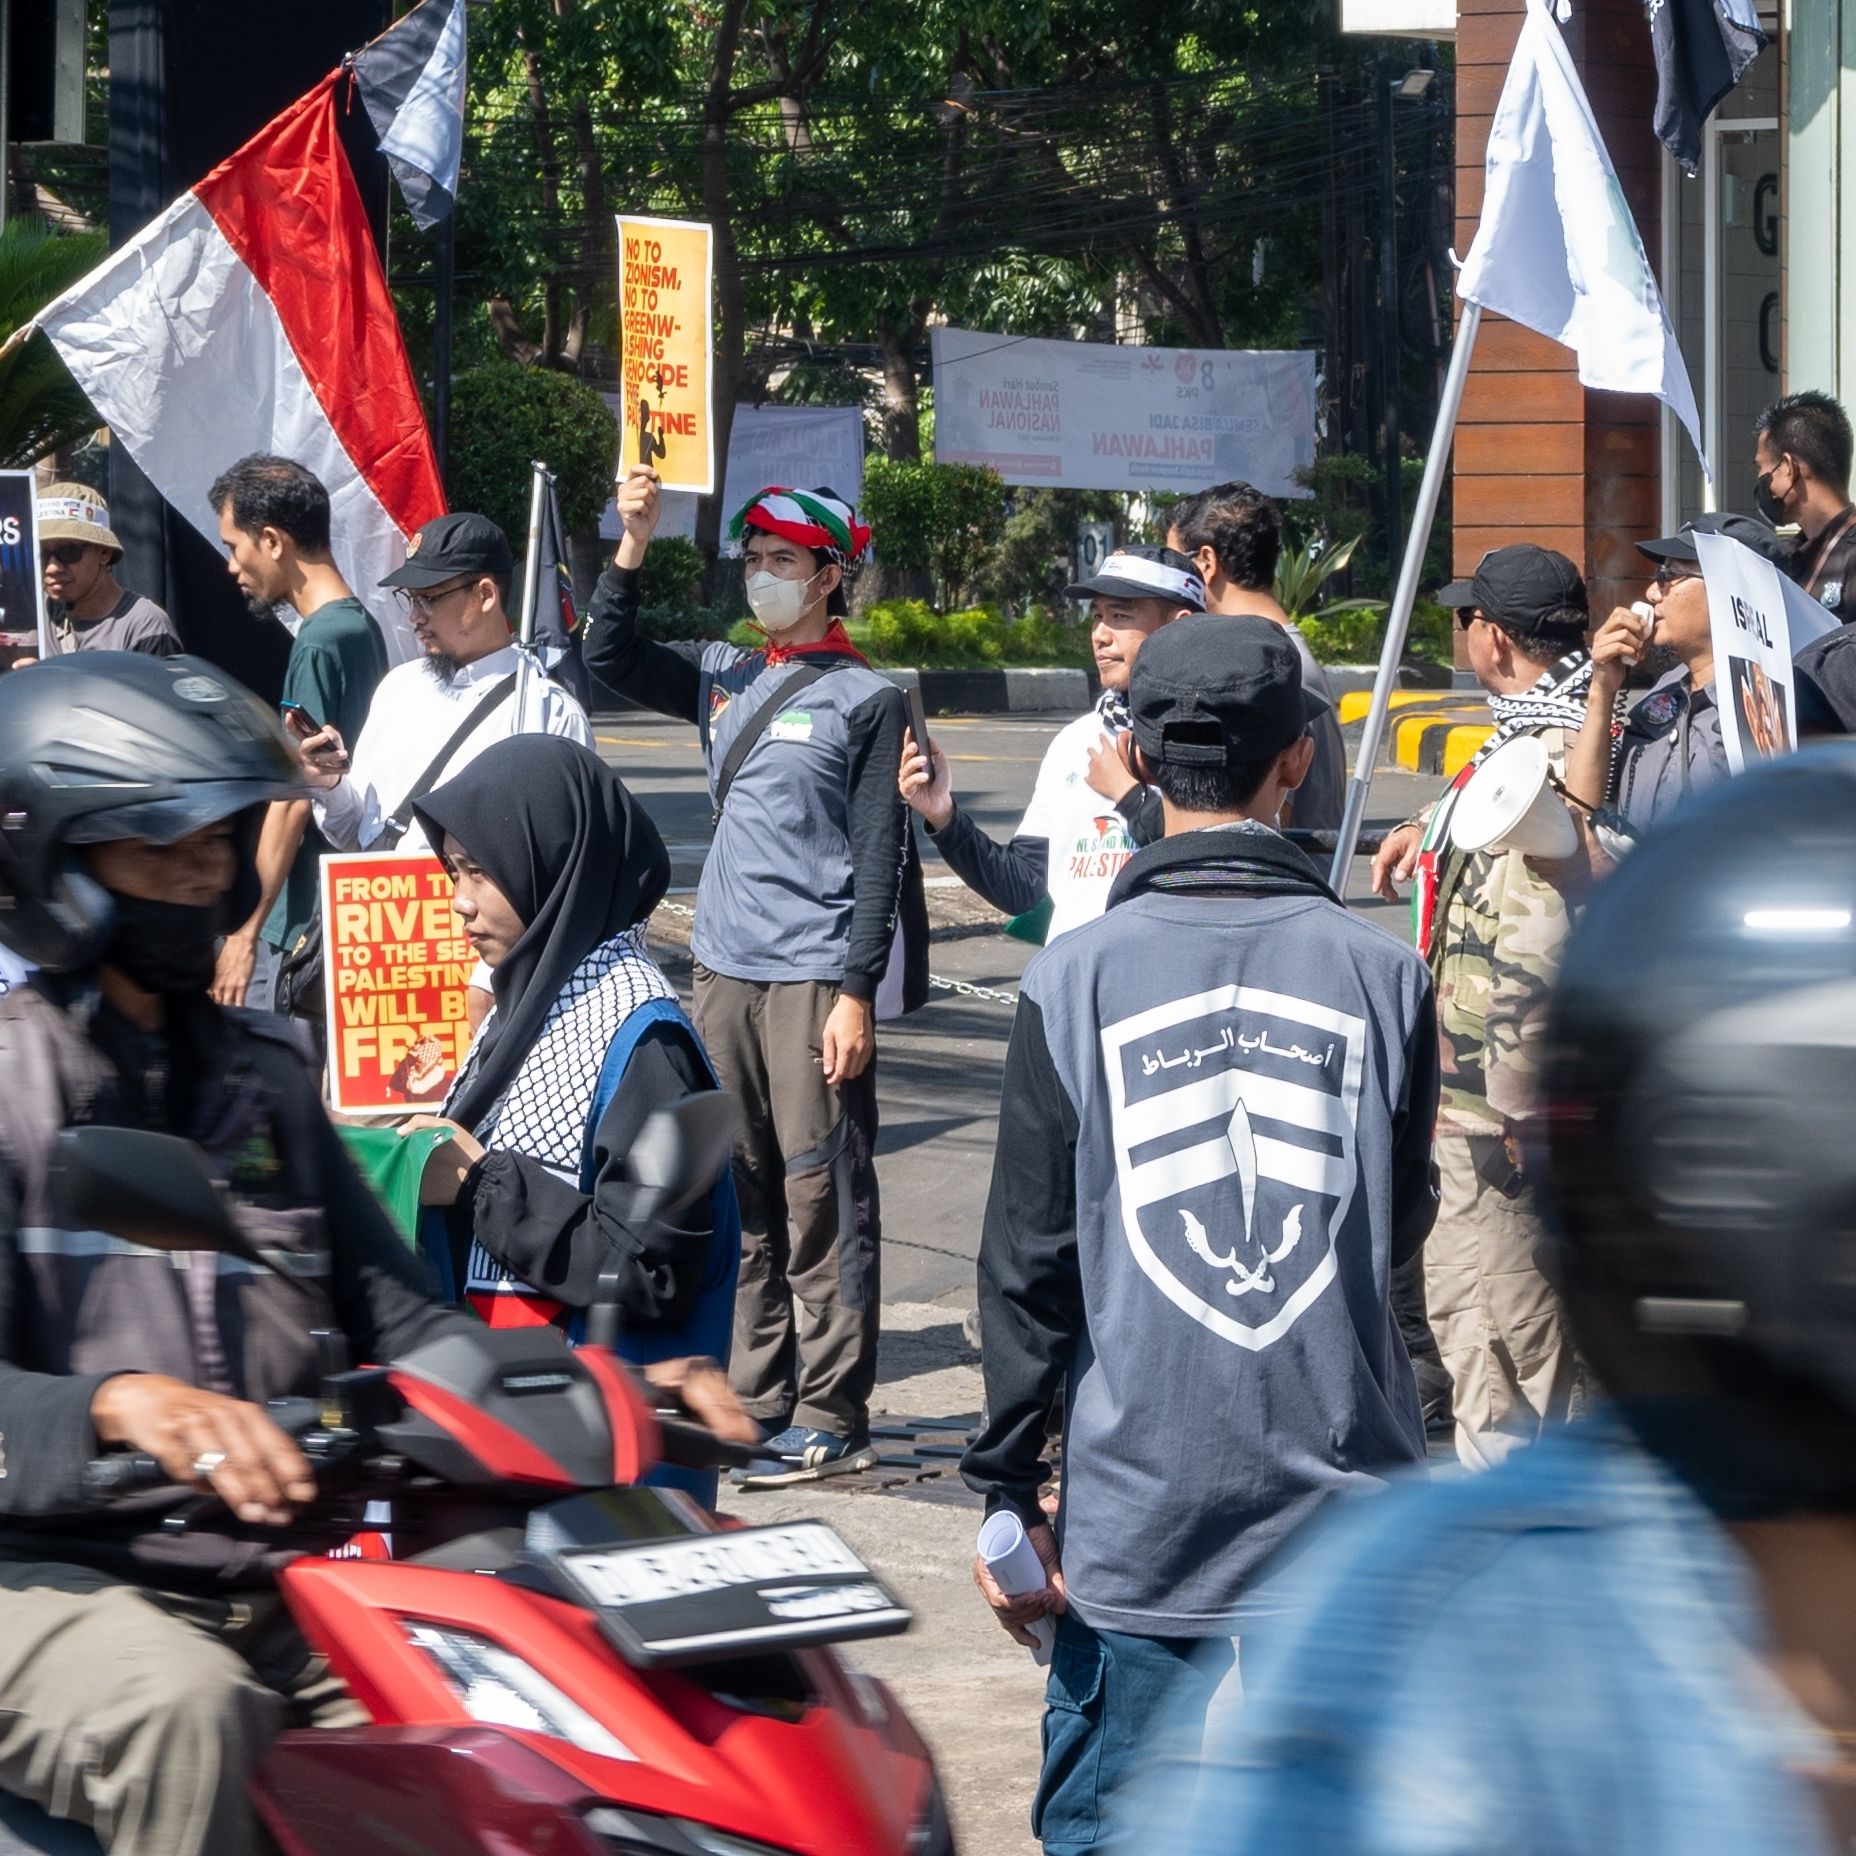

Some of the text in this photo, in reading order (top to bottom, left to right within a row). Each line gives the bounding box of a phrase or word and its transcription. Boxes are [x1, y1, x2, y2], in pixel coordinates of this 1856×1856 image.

[626, 237, 662, 264] NO TO
[625, 261, 682, 291] ZIONISM,
[624, 285, 658, 312] NO TO
[624, 311, 682, 339] GREENW-
[624, 334, 665, 361] ASHING
[624, 357, 689, 388] GENOCIDE
[335, 874, 417, 903] FROM
[338, 946, 372, 968] TO
[380, 942, 428, 965] THE
[338, 962, 475, 993] PALESTIN
[340, 992, 428, 1027] WILL
[1141, 1027, 1335, 1076] أصحاب الرباط
